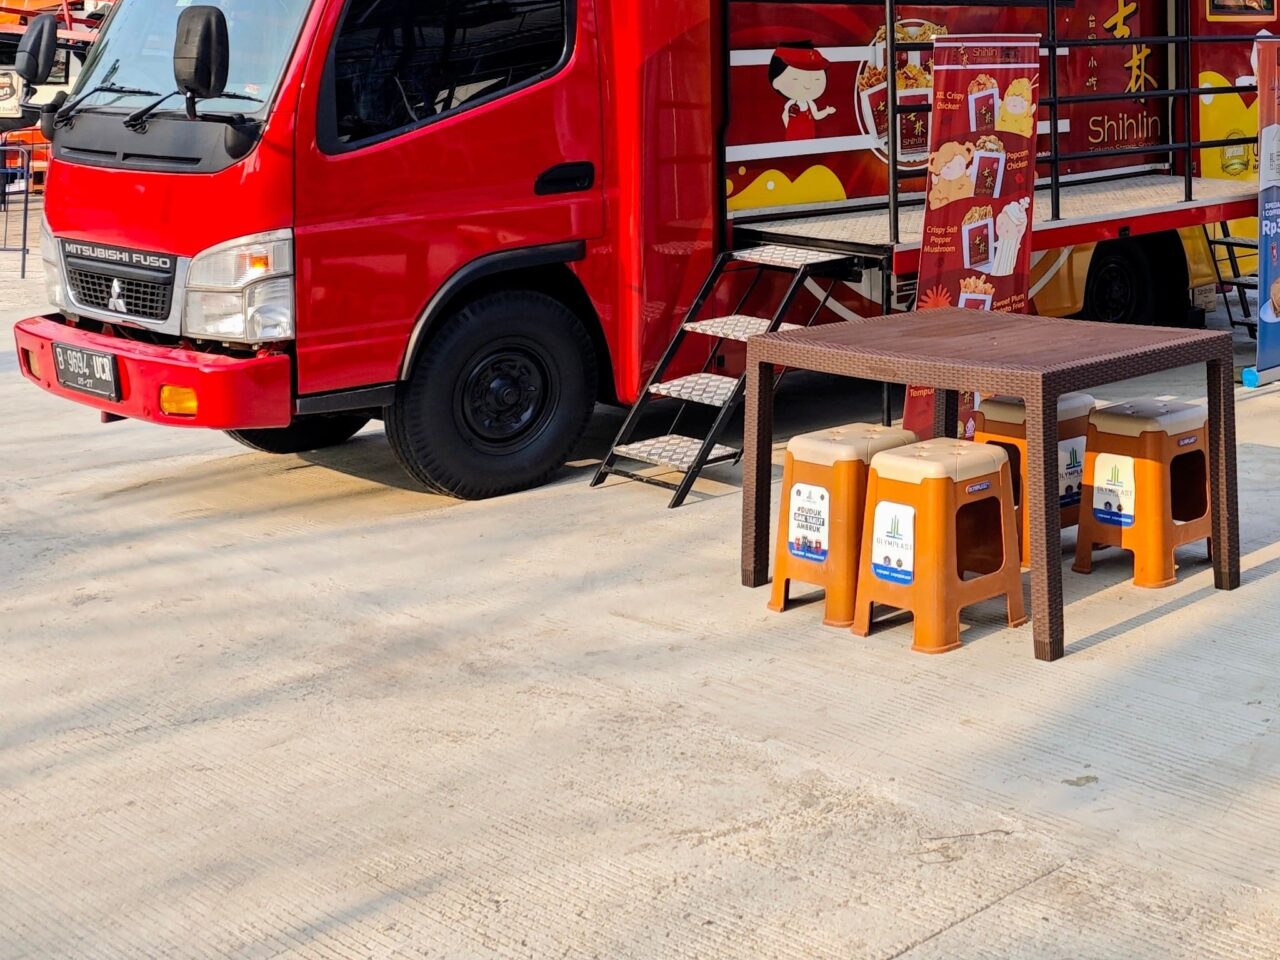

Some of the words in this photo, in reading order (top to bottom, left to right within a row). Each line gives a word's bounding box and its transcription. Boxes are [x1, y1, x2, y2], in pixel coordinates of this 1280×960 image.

[973, 47, 998, 57] Shihlin
[946, 91, 965, 101] Crispy
[1088, 111, 1161, 143] Shihlin
[1007, 160, 1028, 170] Chicken
[926, 226, 945, 234] Crispy
[930, 236, 951, 244] Pepper
[65, 243, 129, 262] MITSUBISHI
[132, 253, 170, 268] FUSO
[993, 297, 1011, 308] Sweet
[1011, 293, 1025, 302] Plum
[56, 348, 65, 369] B
[67, 350, 89, 376] 9694
[93, 355, 112, 382] UCR
[797, 522, 821, 533] AMBRUK
